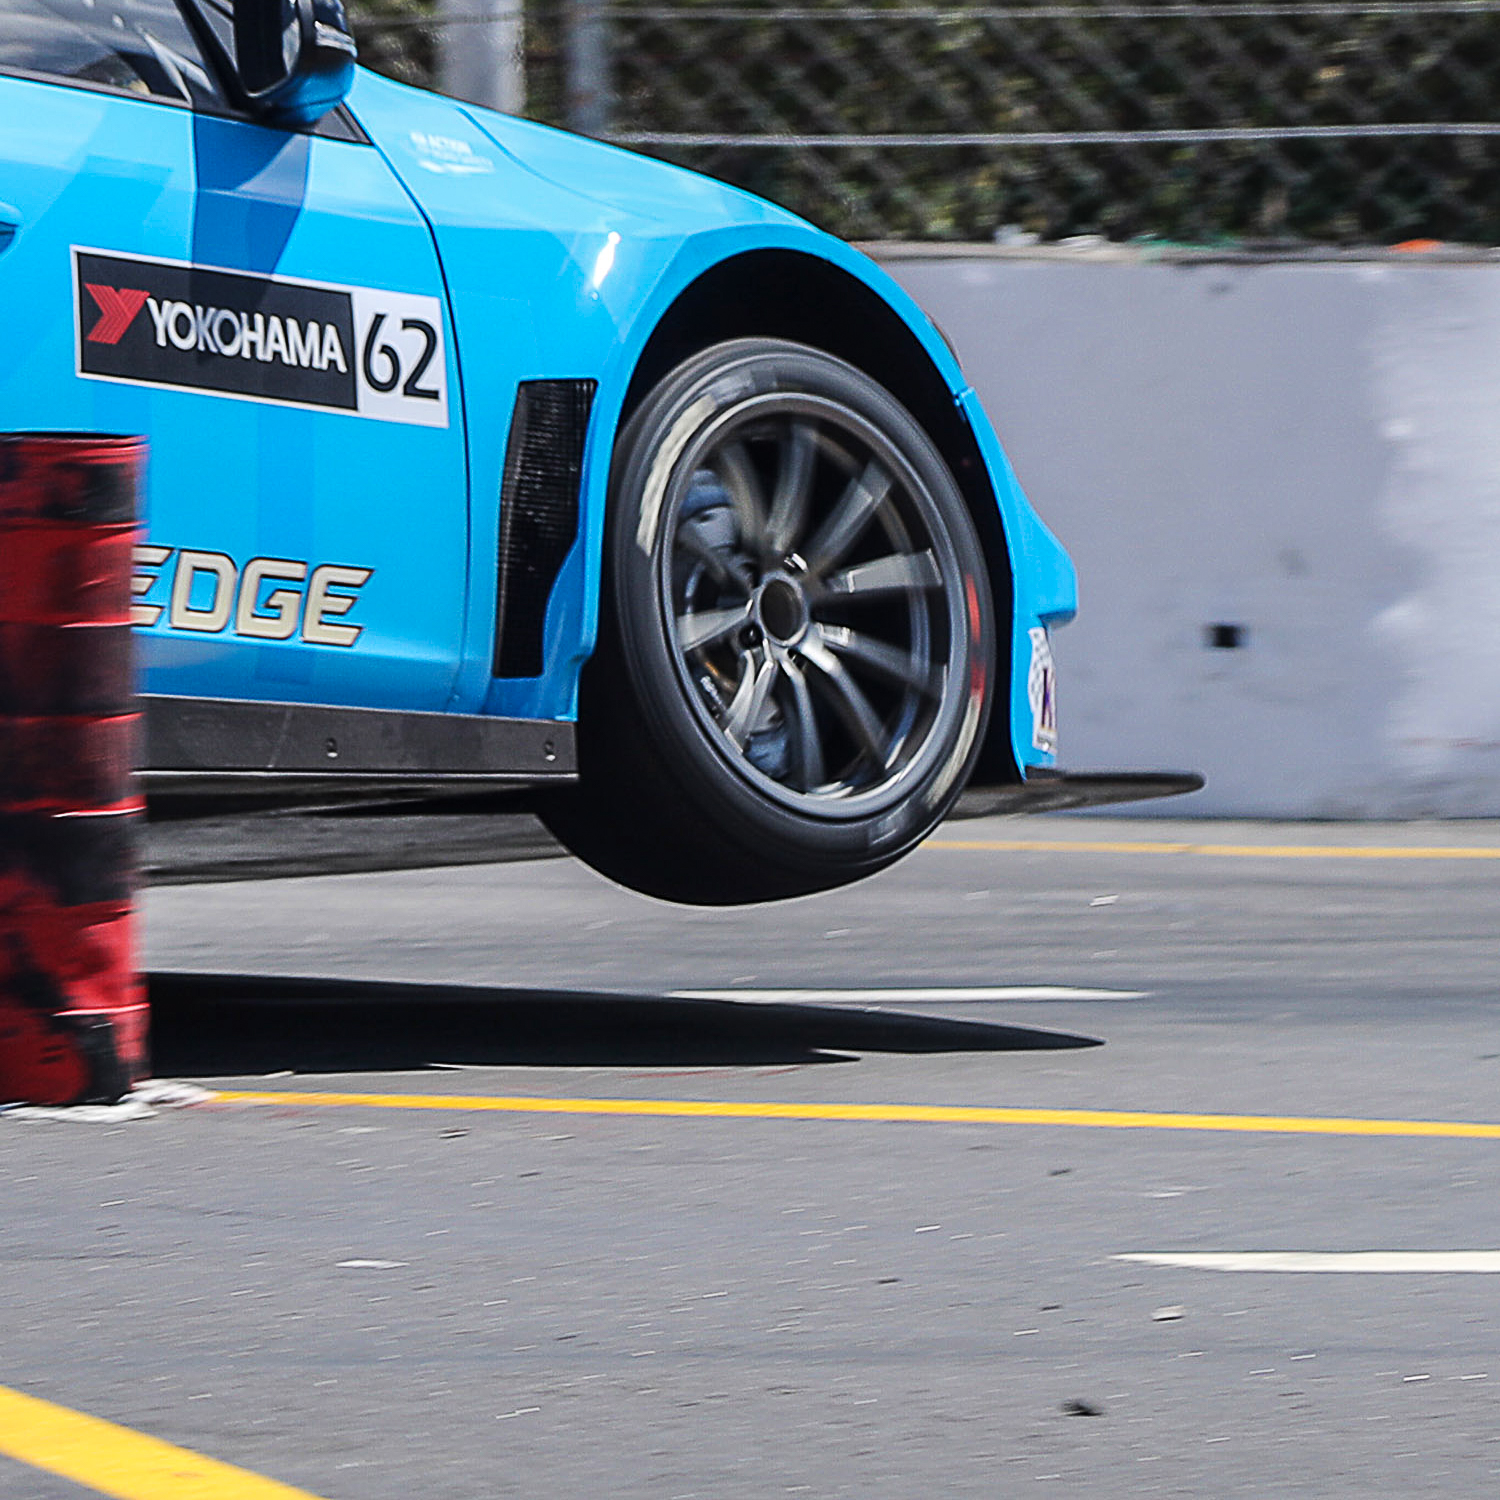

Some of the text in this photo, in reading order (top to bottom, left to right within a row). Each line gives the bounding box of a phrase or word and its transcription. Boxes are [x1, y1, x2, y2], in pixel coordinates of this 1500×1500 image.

[146, 297, 441, 401] YOKOHAMA 62
[131, 543, 375, 648] EDGE
